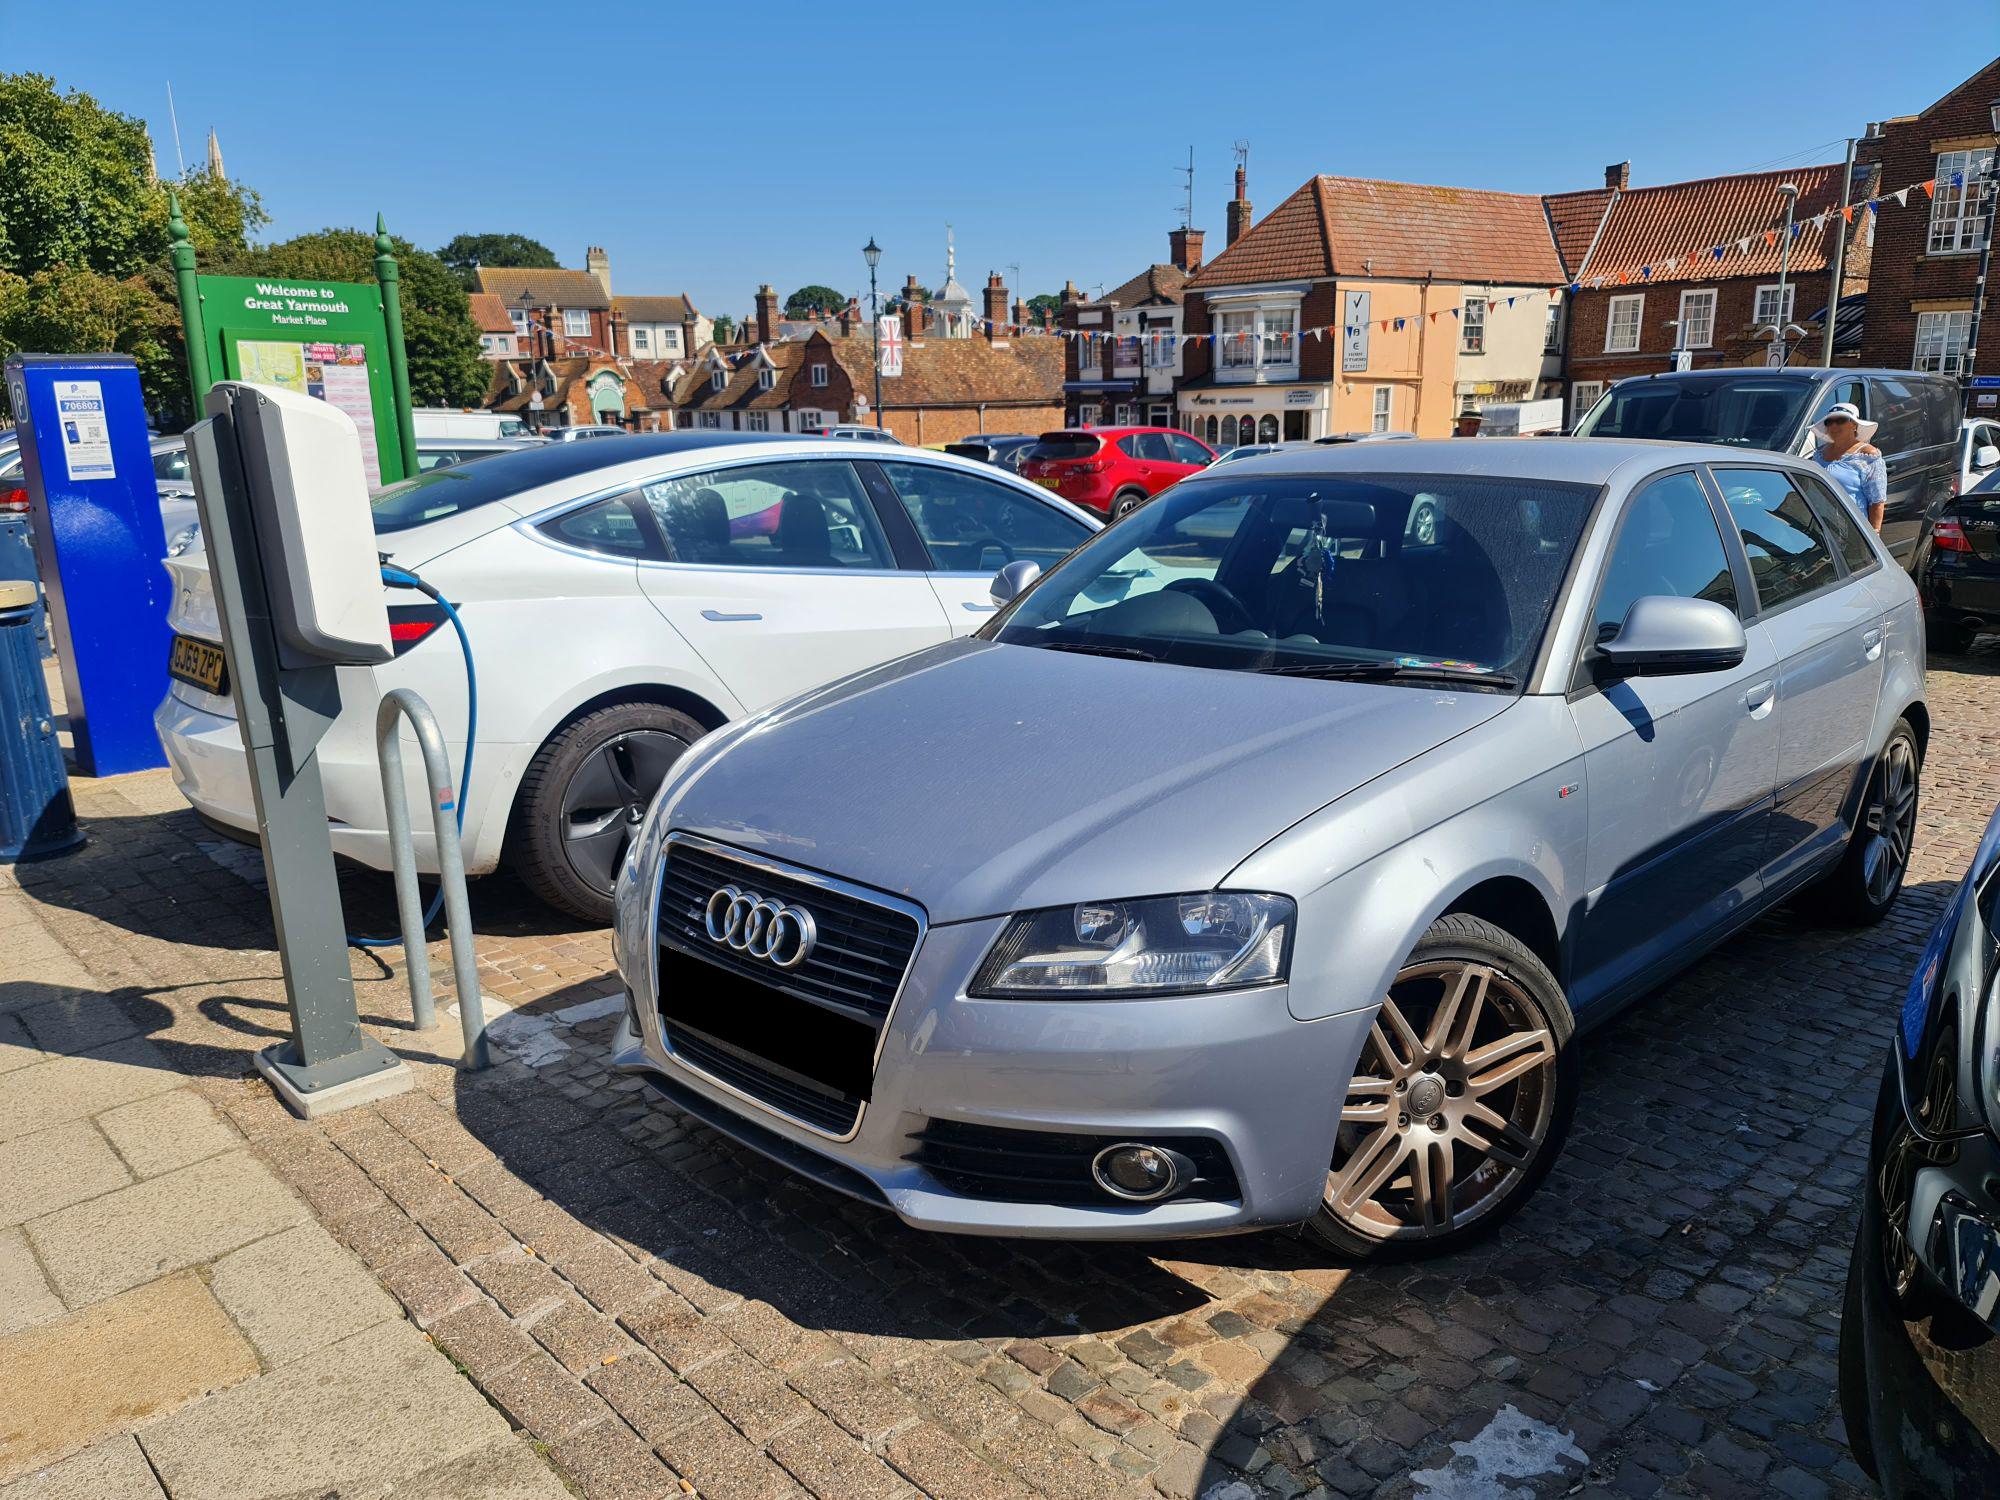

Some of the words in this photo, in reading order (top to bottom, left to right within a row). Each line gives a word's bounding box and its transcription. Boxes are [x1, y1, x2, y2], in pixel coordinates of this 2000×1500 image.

[256, 283, 317, 298] Welcome
[320, 288, 334, 299] to
[244, 297, 283, 310] Great
[286, 299, 349, 313] Yarmouth
[272, 314, 303, 325] Market
[305, 315, 328, 326] Place
[64, 401, 99, 410] 706802
[175, 640, 200, 674] CJ69
[200, 648, 222, 682] ZPC
